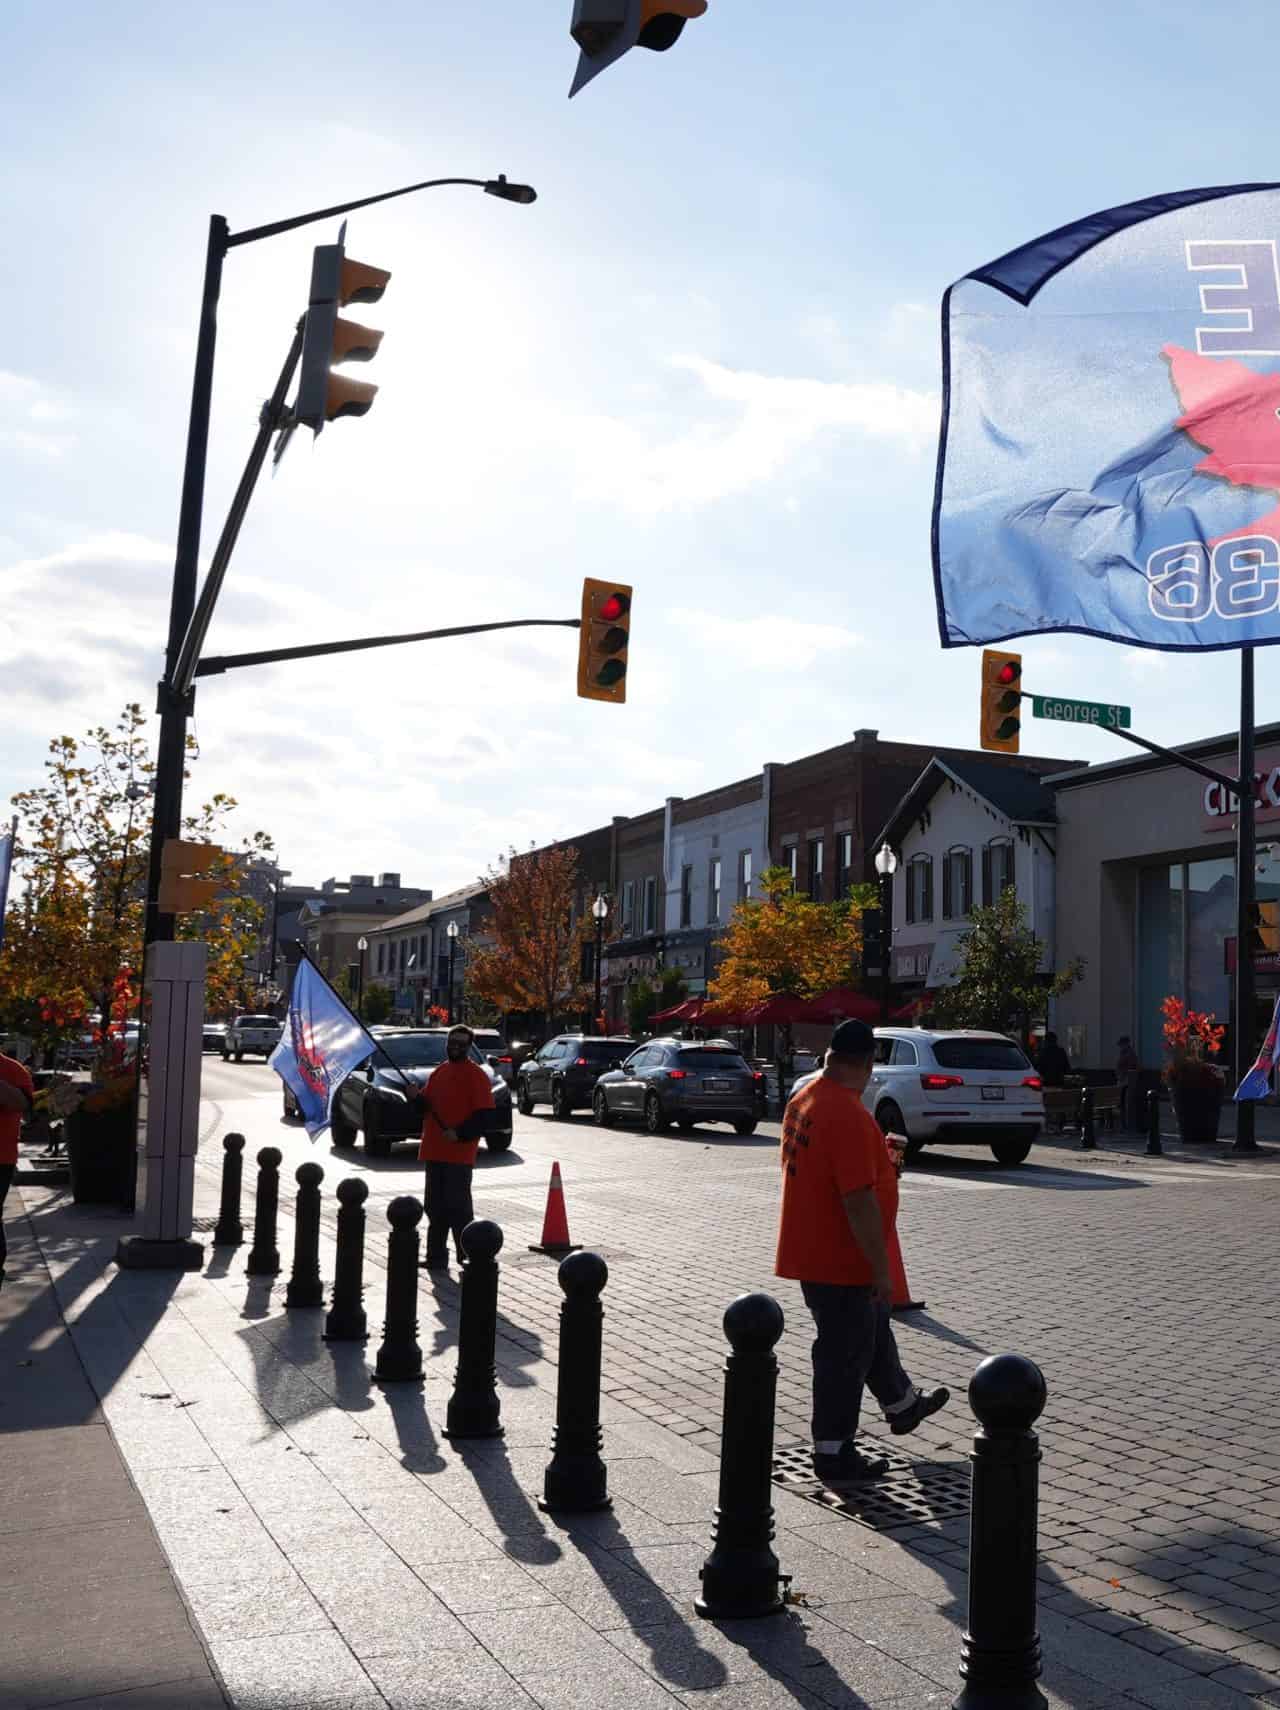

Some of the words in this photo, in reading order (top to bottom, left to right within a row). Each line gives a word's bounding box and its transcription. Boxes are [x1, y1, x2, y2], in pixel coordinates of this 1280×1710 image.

[1042, 699, 1099, 723] George
[1108, 706, 1122, 727] St
[1204, 772, 1262, 816] CI
